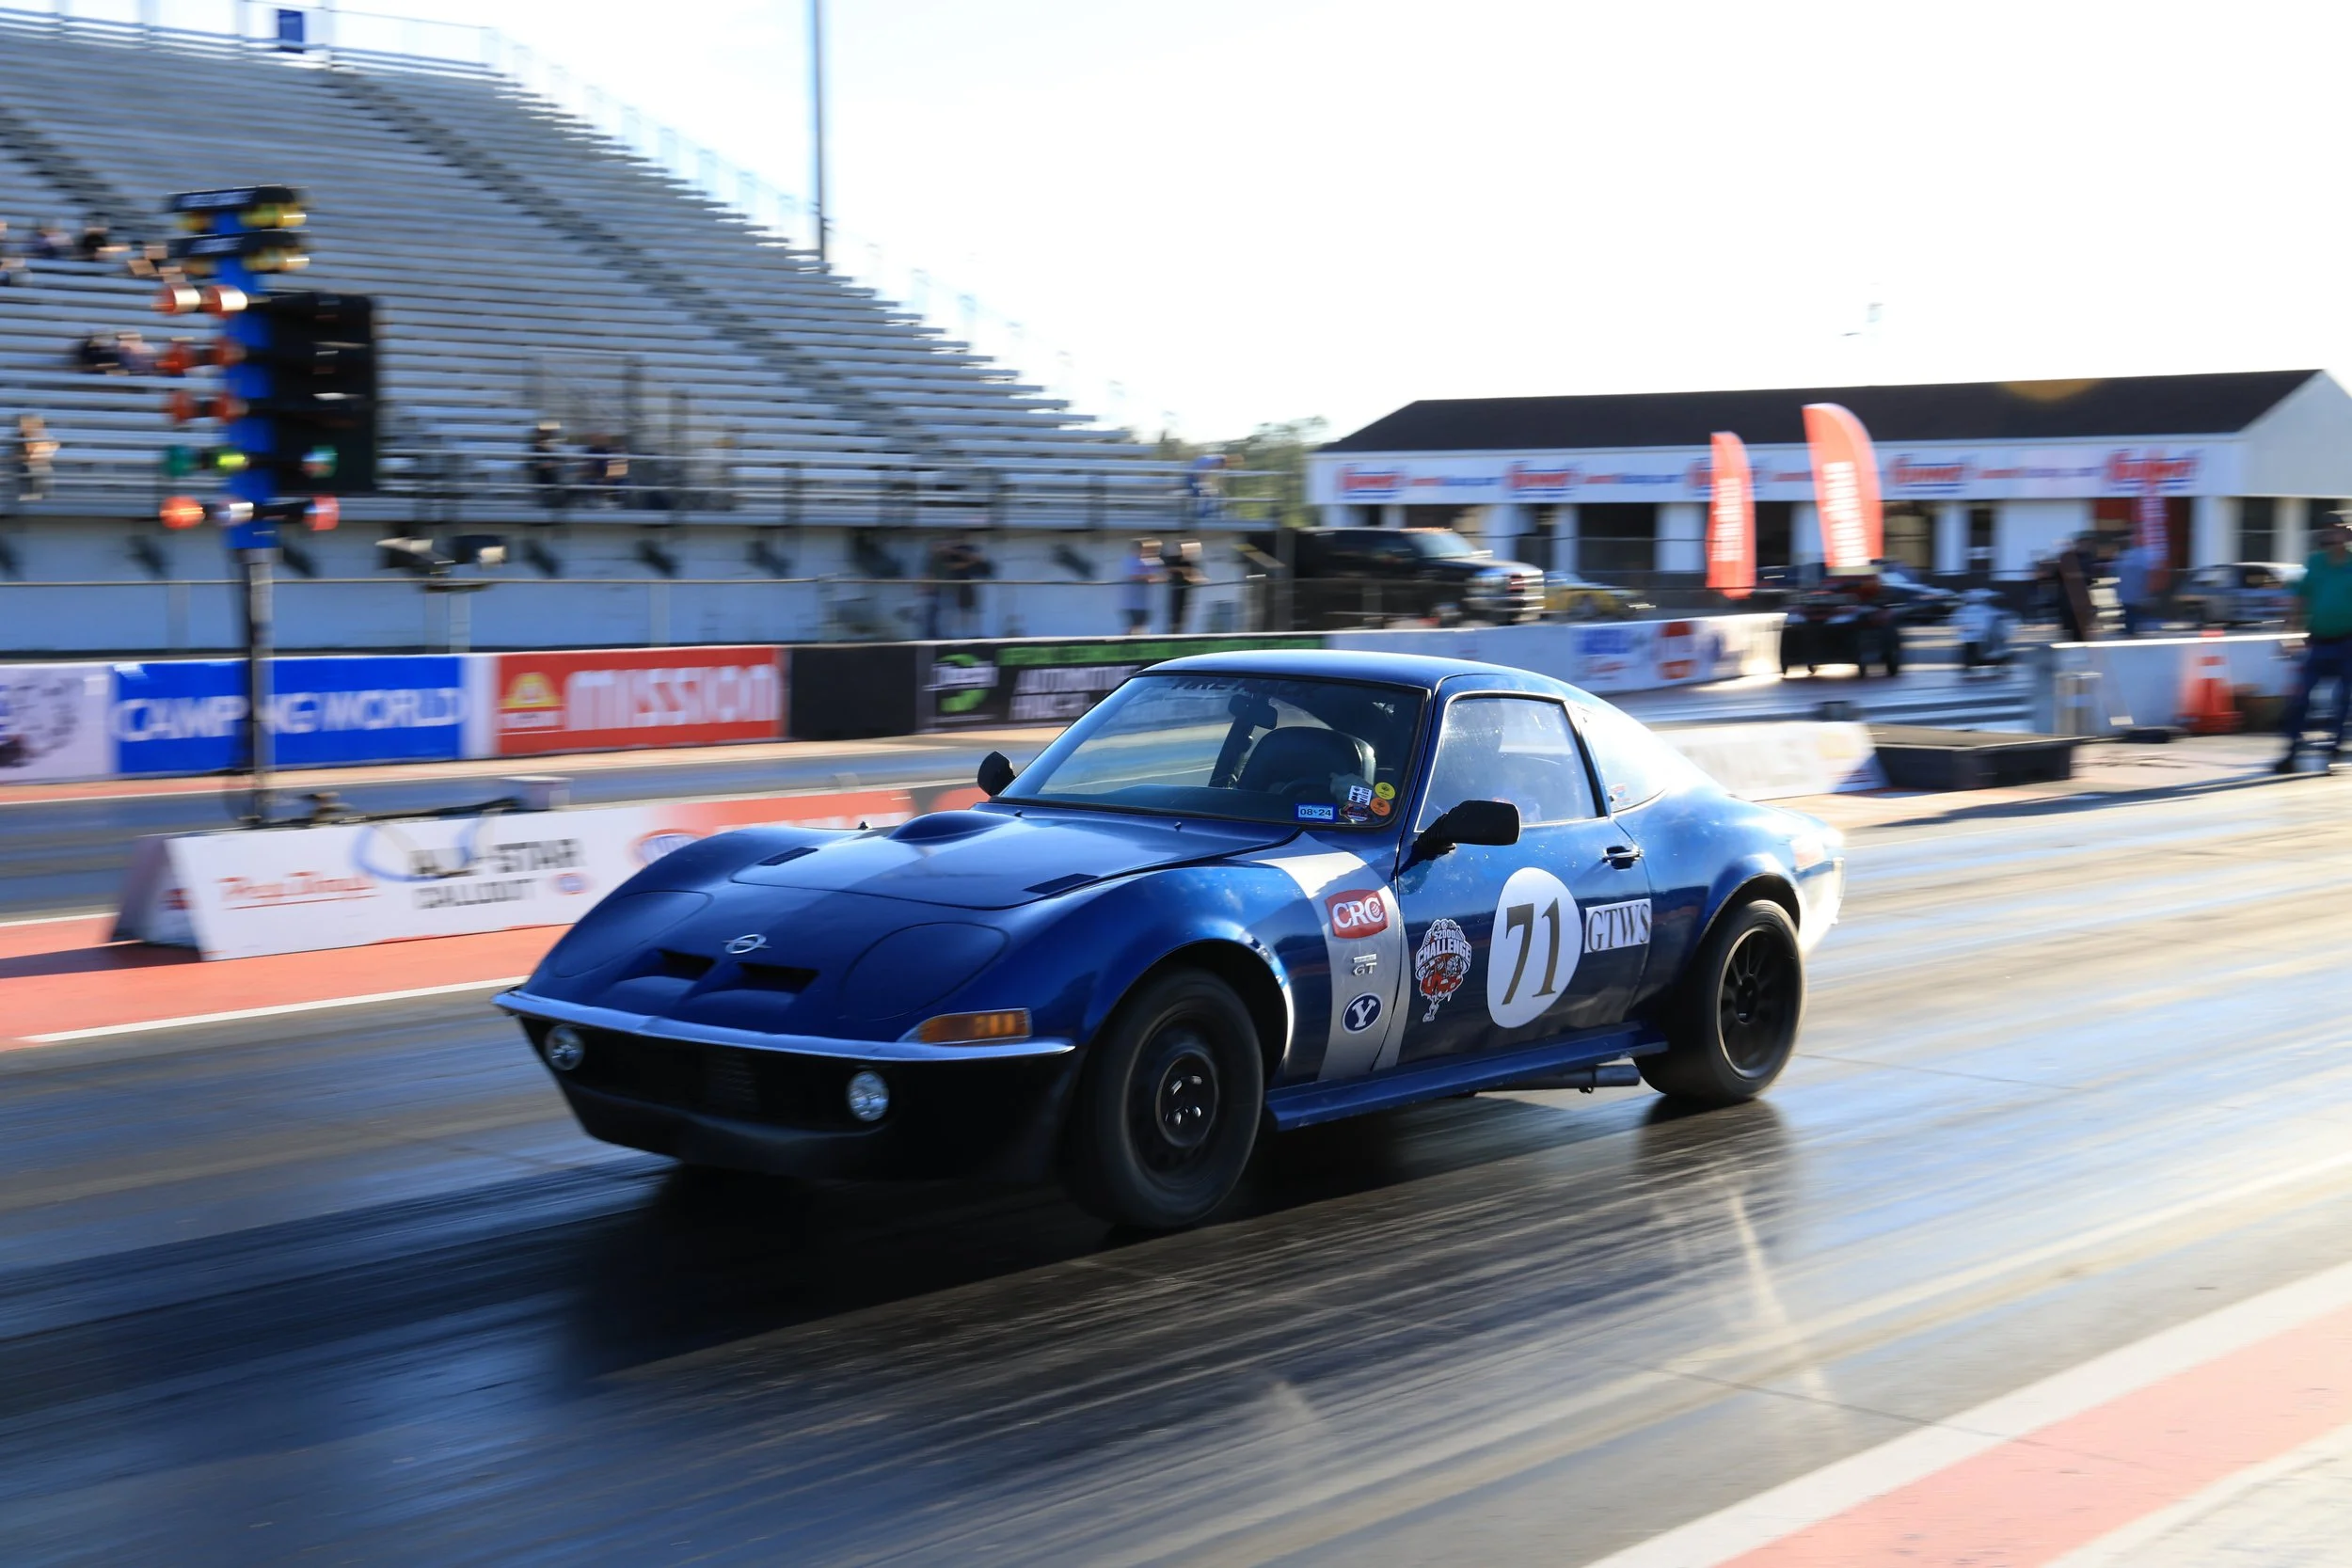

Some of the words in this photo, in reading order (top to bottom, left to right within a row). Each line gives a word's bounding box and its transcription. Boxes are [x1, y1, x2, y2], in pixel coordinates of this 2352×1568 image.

[105, 692, 321, 741] CAMPNG
[323, 688, 469, 731] WORLD
[565, 664, 780, 731] MISSION
[1332, 896, 1384, 928] CRC
[1588, 903, 1649, 952] GTWS
[1353, 962, 1377, 976] GT
[1417, 938, 1471, 969] CHALLENGE
[1502, 897, 1560, 1006] 71
[1352, 998, 1377, 1028] Y
